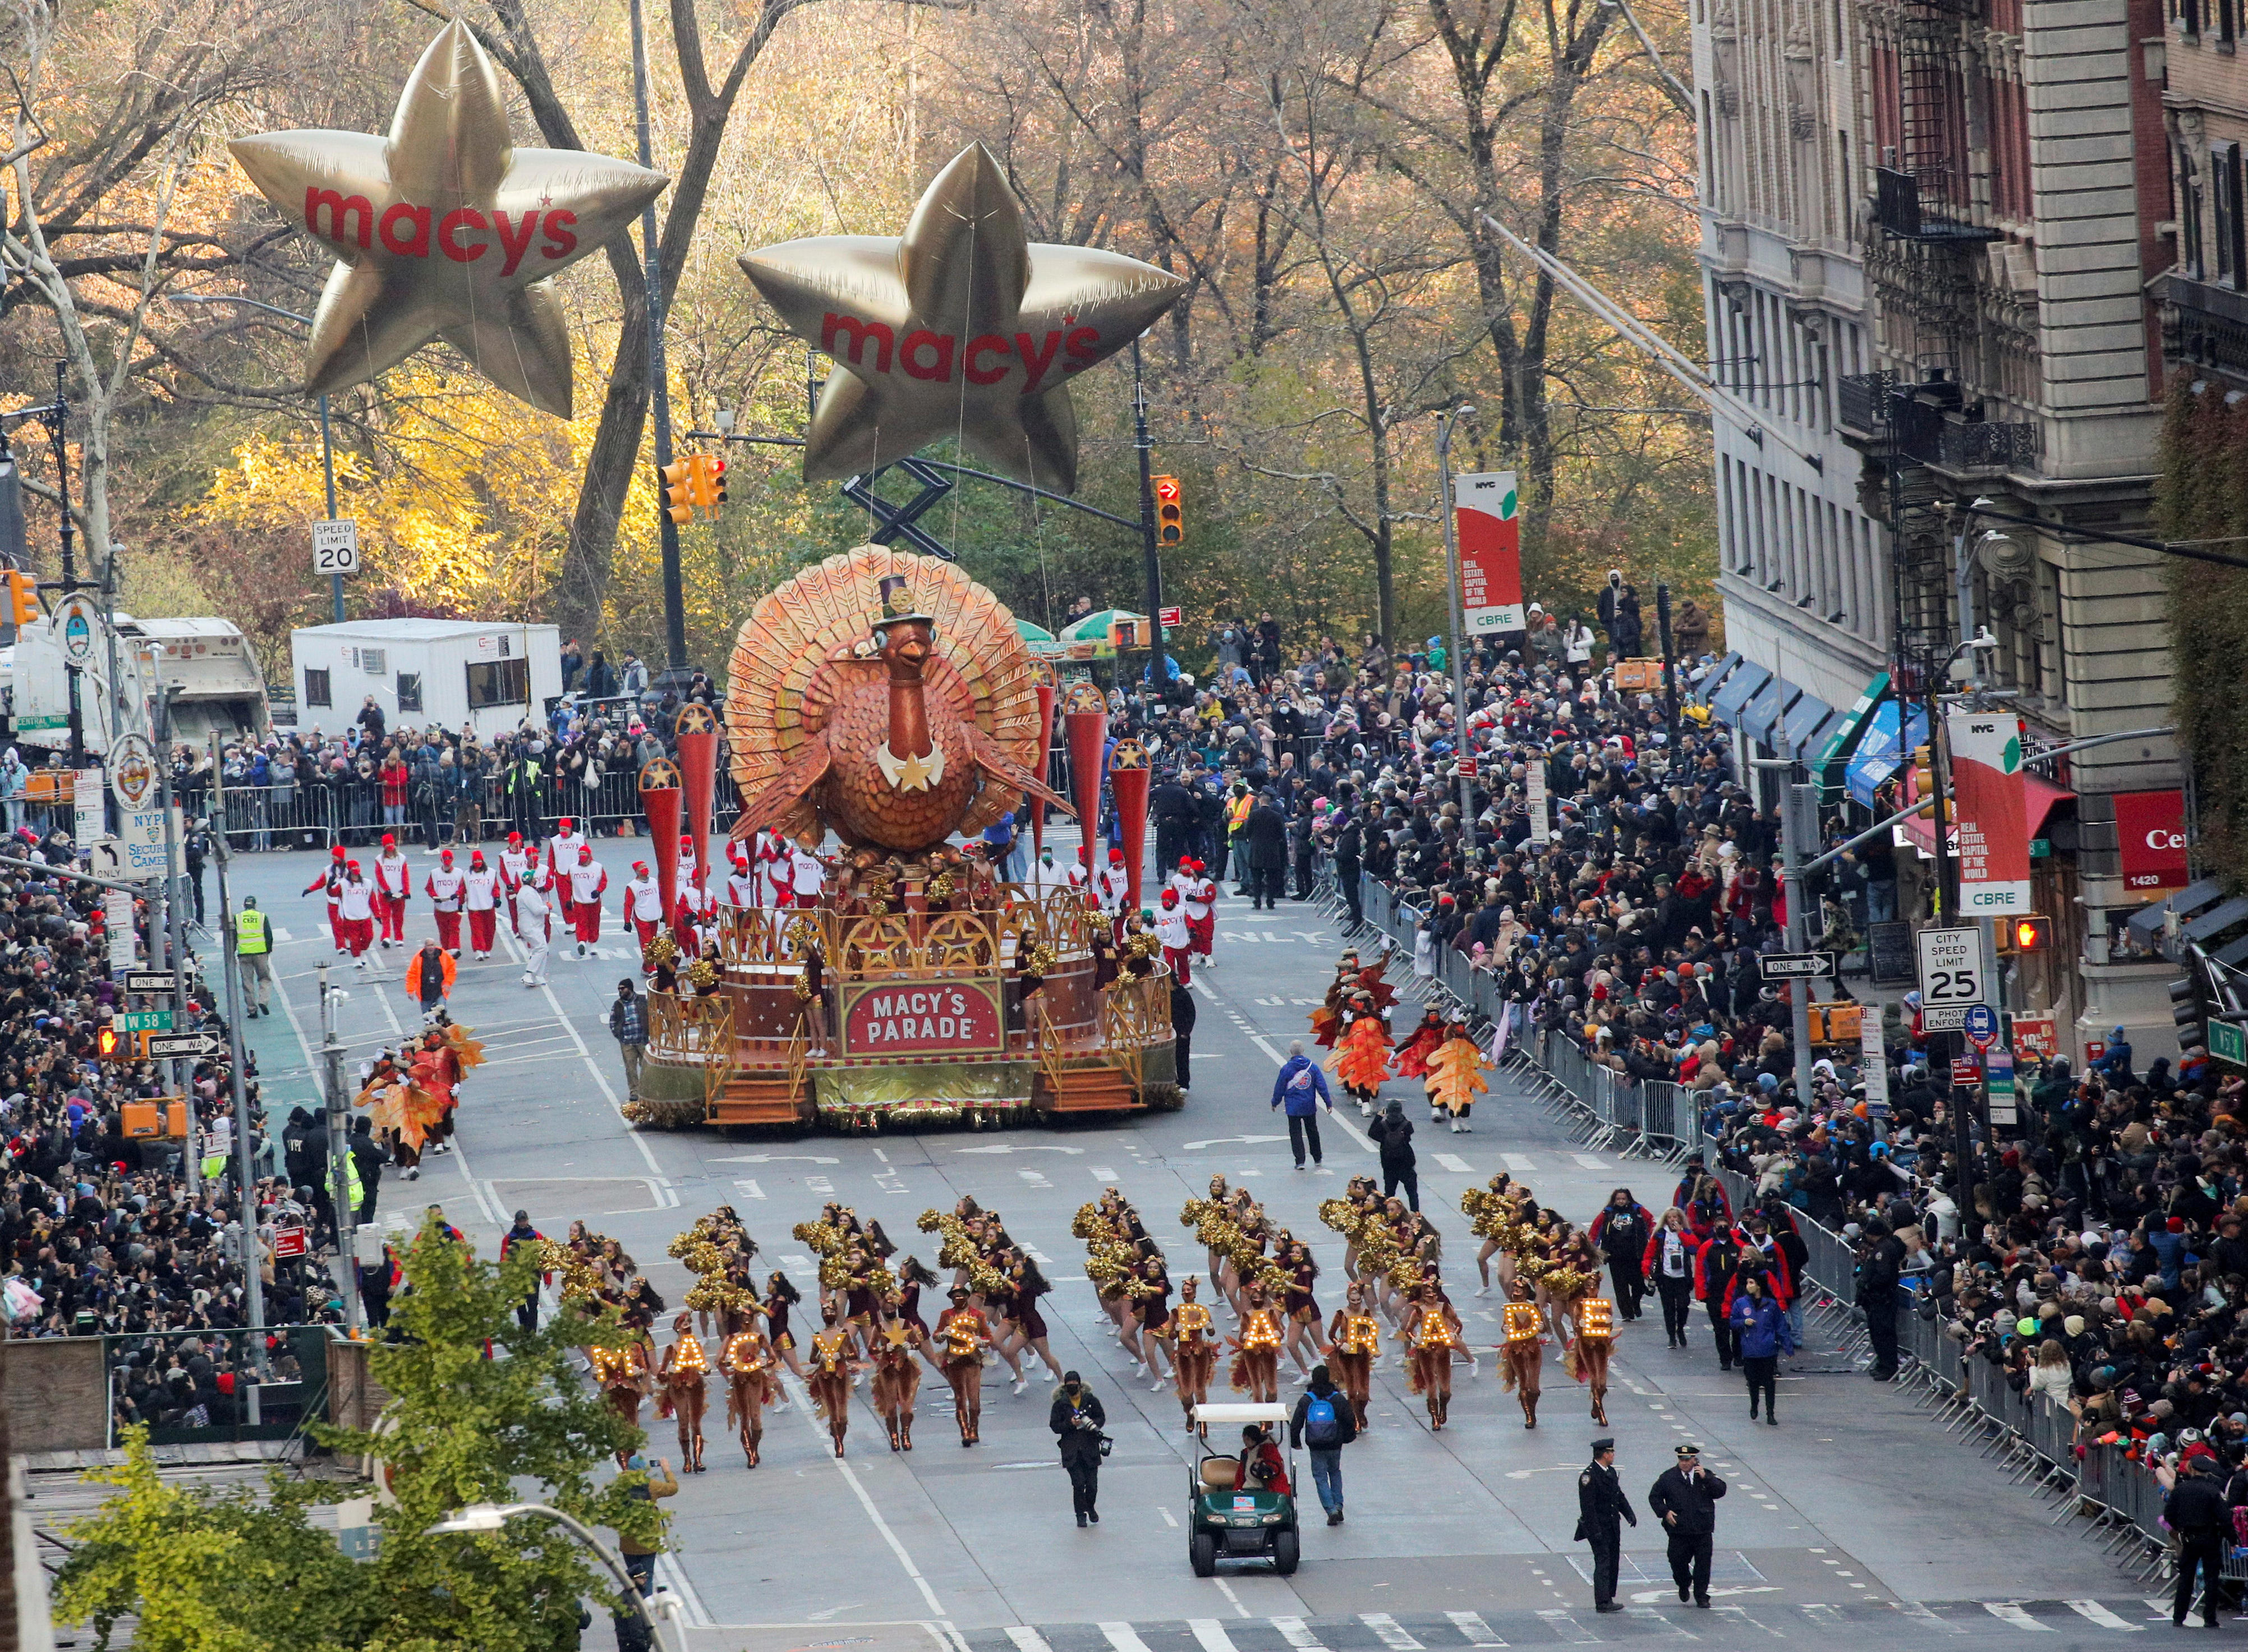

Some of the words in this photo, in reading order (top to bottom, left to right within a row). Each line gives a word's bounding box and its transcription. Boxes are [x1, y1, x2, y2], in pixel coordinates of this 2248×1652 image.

[316, 524, 351, 534] SPEED
[321, 536, 348, 545] LIMIT
[320, 547, 352, 568] 20
[1463, 560, 1478, 568] REAL
[1464, 569, 1484, 578] ESTATE
[1464, 578, 1488, 587] CAPITAL
[1465, 588, 1473, 596] OF
[1474, 587, 1484, 596] THE
[1465, 596, 1487, 606] WORLD
[1477, 614, 1513, 627] CBRE
[65, 651, 95, 665] ARGENTINA
[18, 717, 45, 725] CENTRAL
[1971, 724, 1994, 734] NYC
[135, 813, 167, 827] NYP
[1960, 822, 1977, 833] REAL
[1961, 833, 1985, 844] ESTATE
[128, 843, 180, 855] SECURIY
[1962, 845, 1989, 856] CAPITAL
[1963, 857, 1971, 868] OF
[1973, 857, 1985, 867] THE
[97, 869, 121, 878] ONLY
[1963, 868, 1988, 879] WORLD
[2130, 875, 2159, 886] 1420
[1973, 892, 2015, 905] CBRE
[1936, 934, 1961, 944] CITY
[1932, 945, 1967, 955] SPEED
[1772, 961, 1793, 971] ONE
[1801, 960, 1823, 970] WAY
[1936, 957, 1964, 968] LIMIT
[135, 978, 154, 987] ONE
[163, 978, 175, 986] WA
[1930, 970, 1976, 999] 25
[127, 1015, 139, 1028] W
[144, 1014, 159, 1027] 58
[1929, 1018, 1966, 1027] ENFORC
[867, 1016, 973, 1043] PARADE
[155, 1042, 175, 1051] ONE
[188, 1039, 209, 1050] WAY
